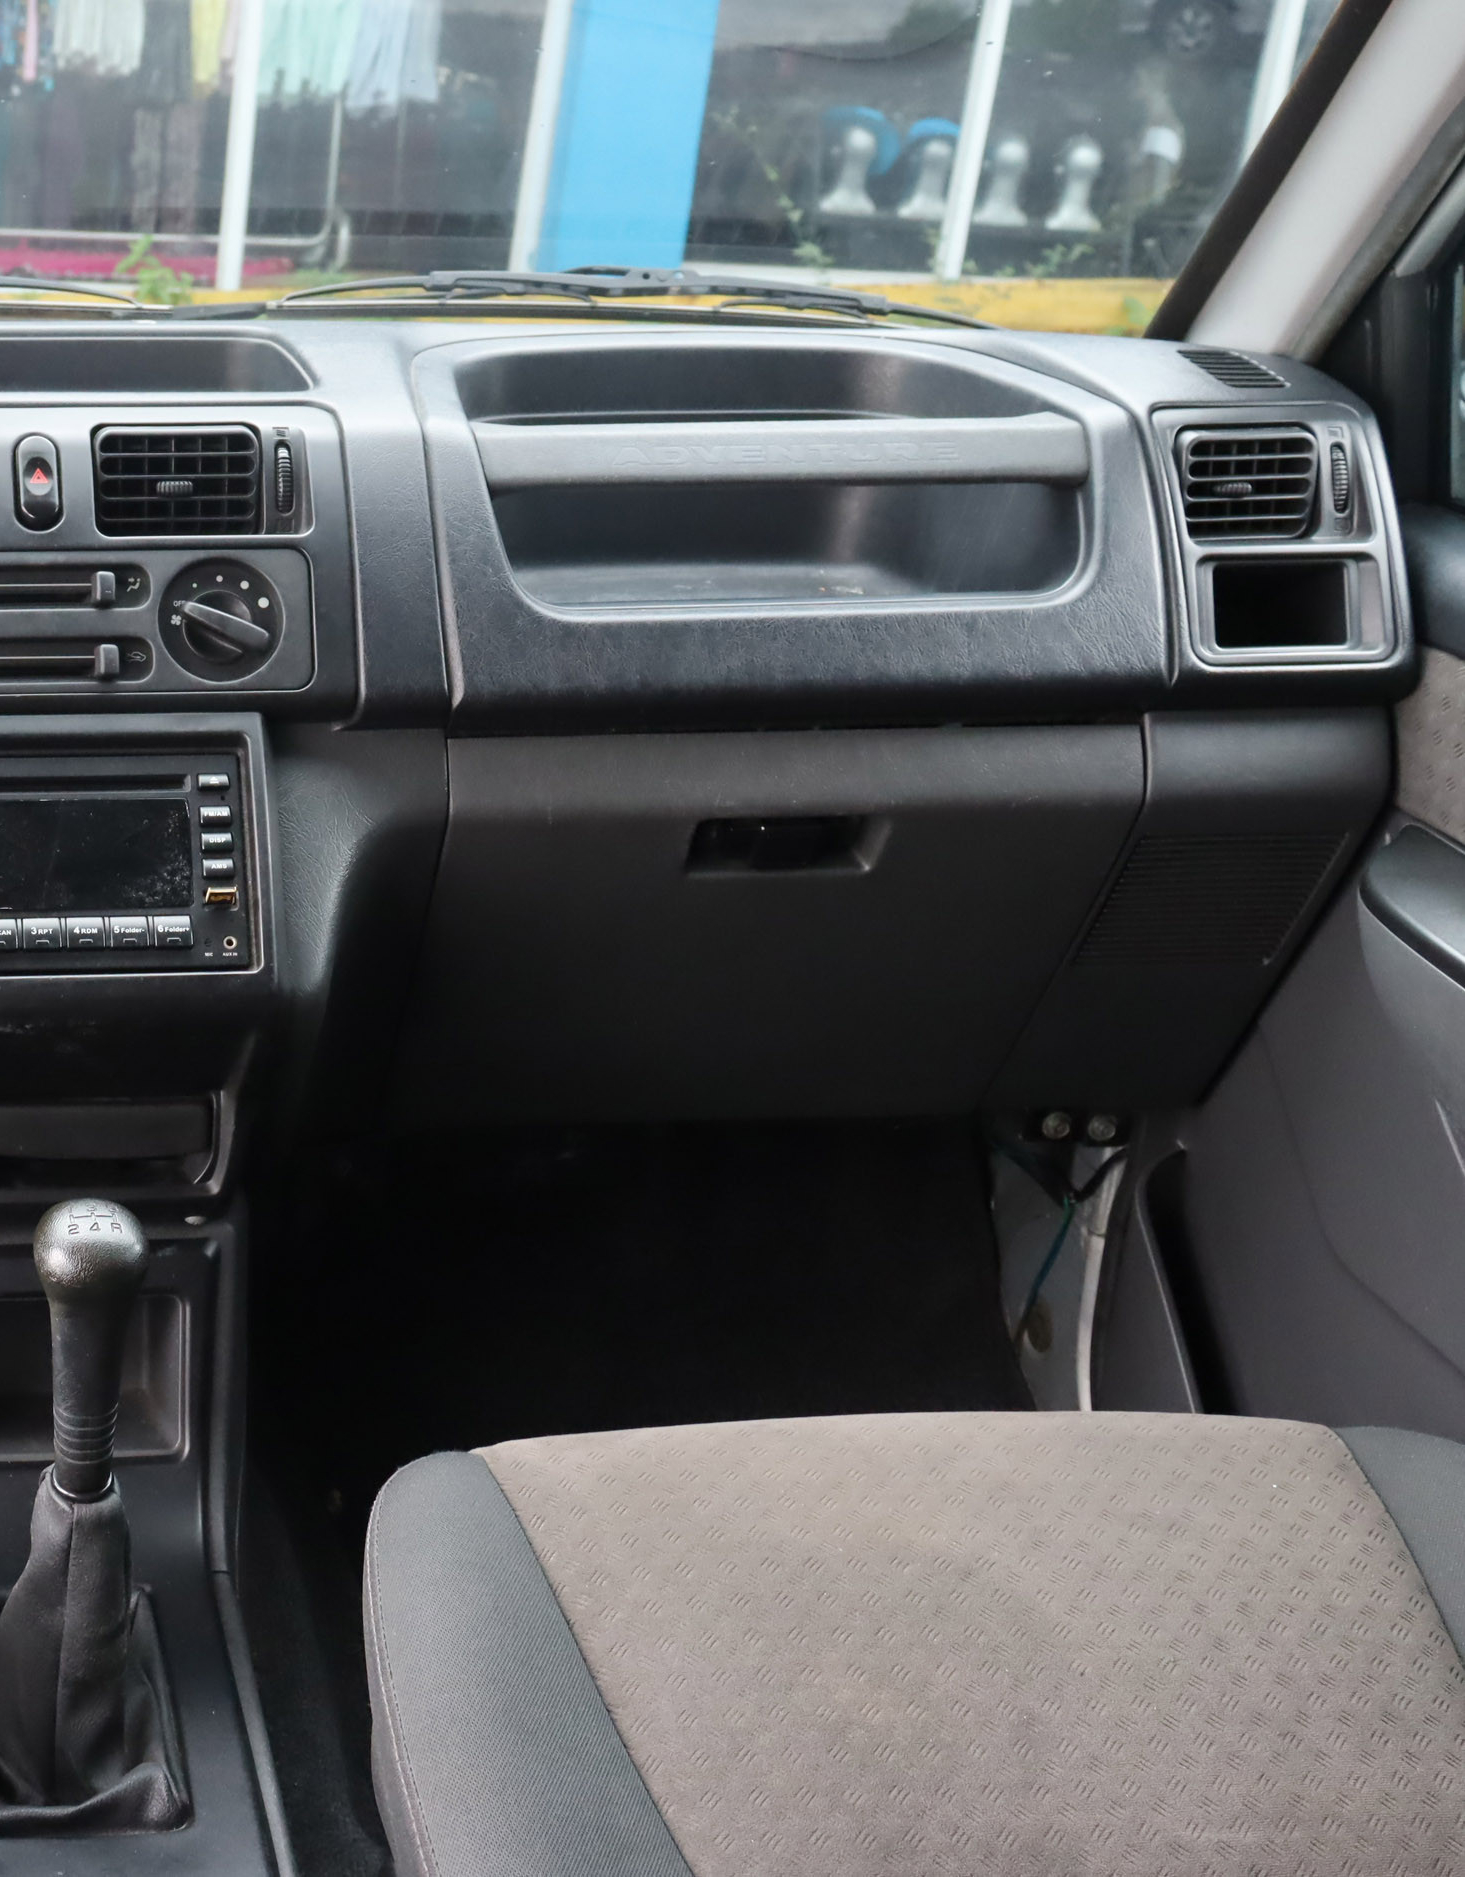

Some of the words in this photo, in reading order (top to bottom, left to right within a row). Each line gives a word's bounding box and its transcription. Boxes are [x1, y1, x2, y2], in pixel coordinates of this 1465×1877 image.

[613, 442, 961, 466] ADVENTURE
[31, 927, 37, 935] 3
[73, 926, 80, 934] 4
[114, 926, 120, 934] 5
[67, 1223, 80, 1235] 2
[89, 1222, 102, 1232] 4
[110, 1222, 123, 1234] R
